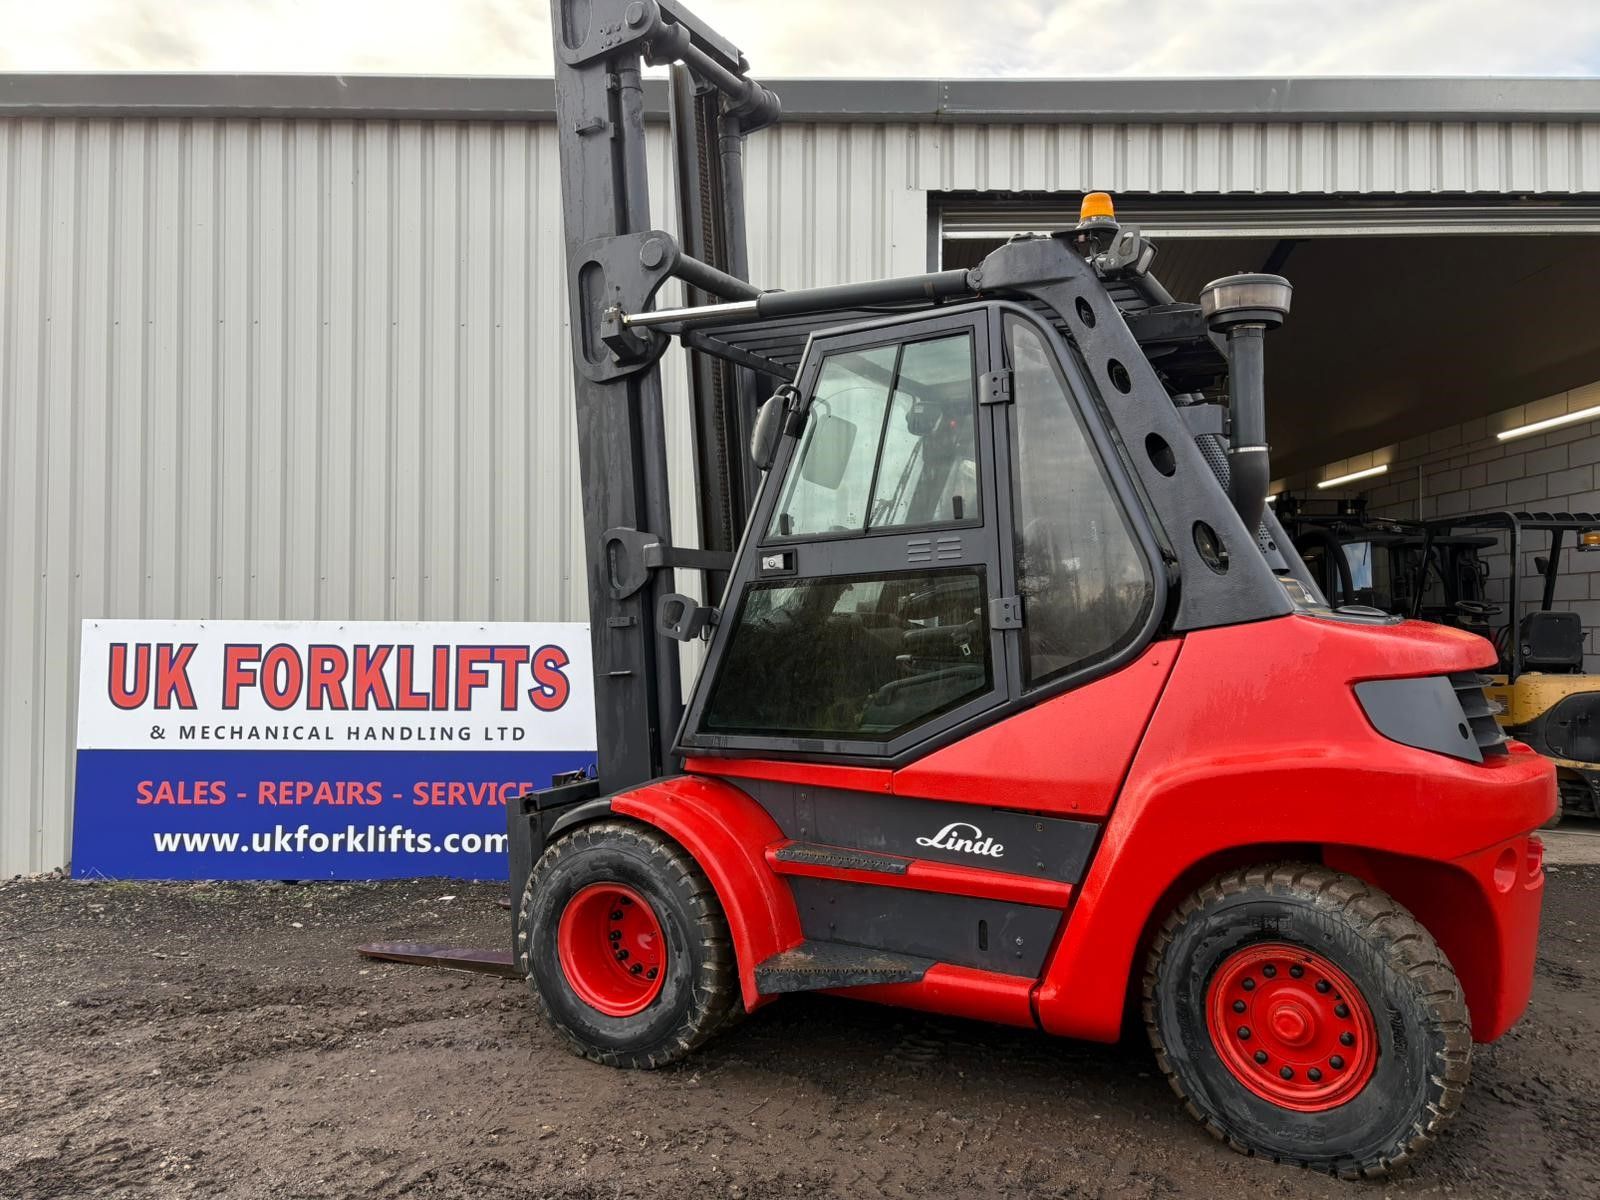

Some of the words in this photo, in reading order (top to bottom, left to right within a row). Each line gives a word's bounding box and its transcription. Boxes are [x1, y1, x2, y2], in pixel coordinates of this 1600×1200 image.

[108, 643, 199, 710] UK
[221, 643, 571, 712] FORKLIFTS
[150, 725, 166, 740] &
[179, 725, 335, 740] MECHANICAL
[347, 726, 472, 741] HANDLING
[485, 726, 526, 741] LTD
[136, 781, 227, 805] SALES
[257, 782, 383, 805] REPAIRS
[153, 824, 508, 853] www.ukforklifts.com
[915, 822, 1004, 857] Linde
